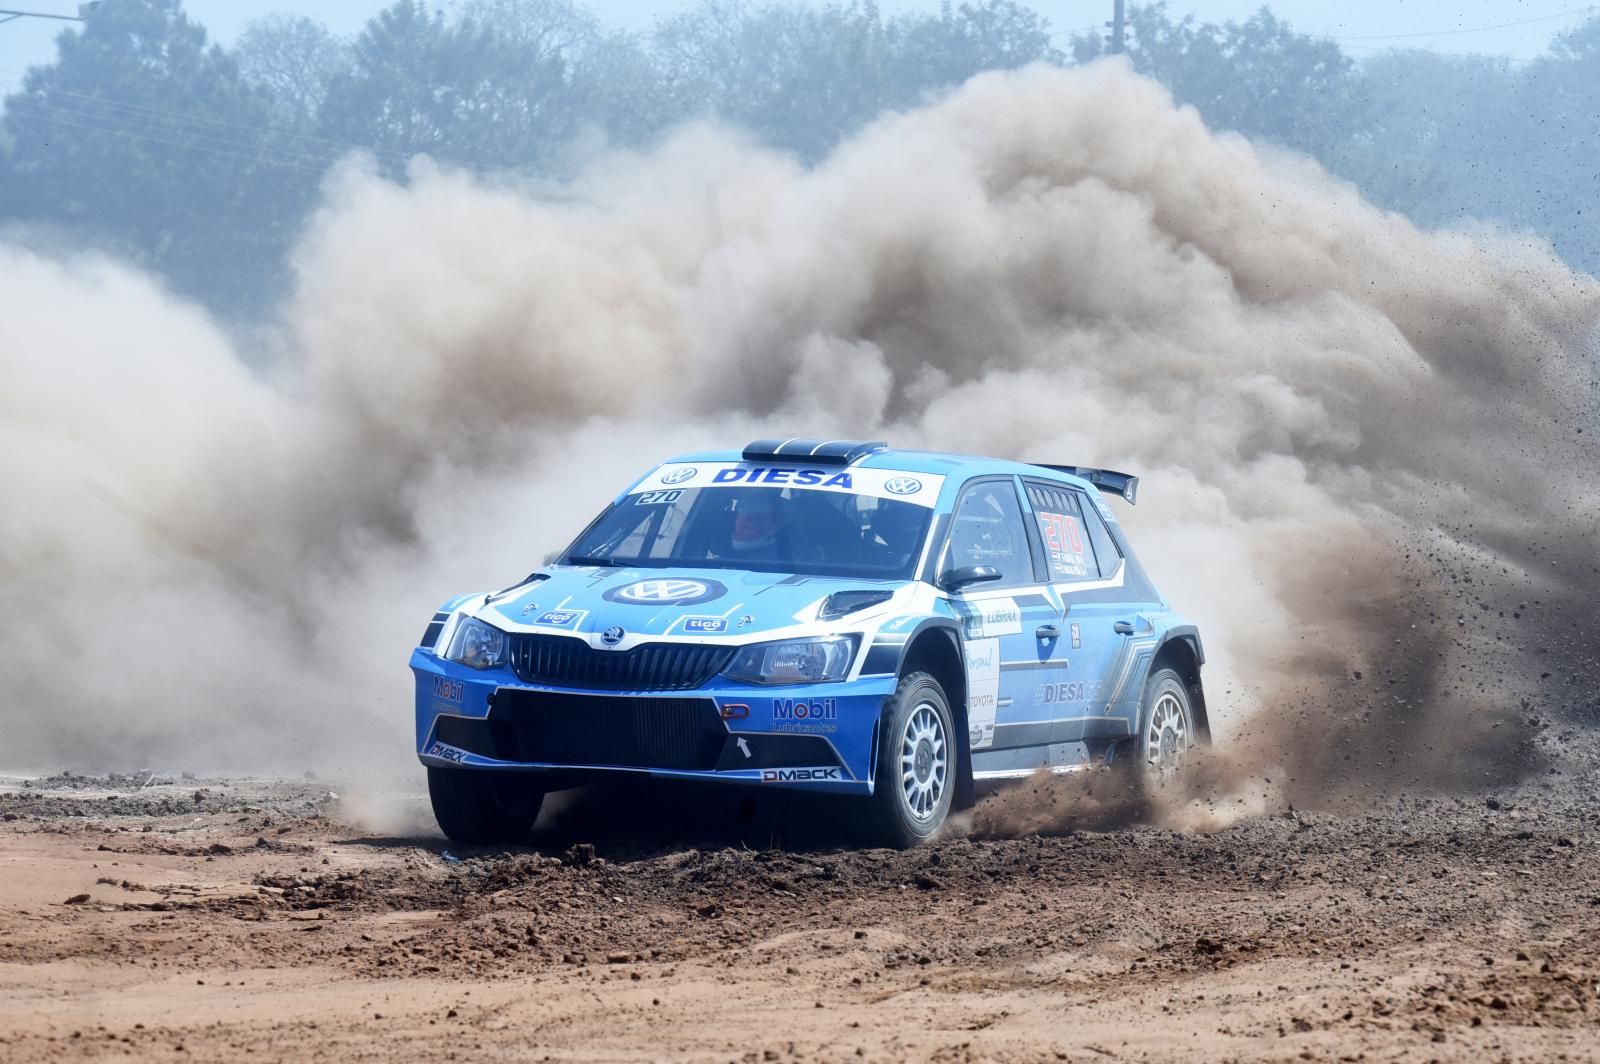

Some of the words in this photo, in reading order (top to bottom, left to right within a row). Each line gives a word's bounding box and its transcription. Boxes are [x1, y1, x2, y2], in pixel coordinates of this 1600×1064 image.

[711, 467, 852, 489] DIESA
[638, 490, 682, 504] 270
[1040, 512, 1083, 553] 270
[543, 612, 572, 624] tigo
[987, 608, 1017, 624] LUBRAX
[690, 620, 721, 631] tigo
[433, 675, 465, 704] Mobil
[772, 697, 837, 720] Mobil
[969, 694, 994, 708] TOYOTA
[430, 743, 467, 763] DMACK
[763, 768, 839, 782] DMACK
